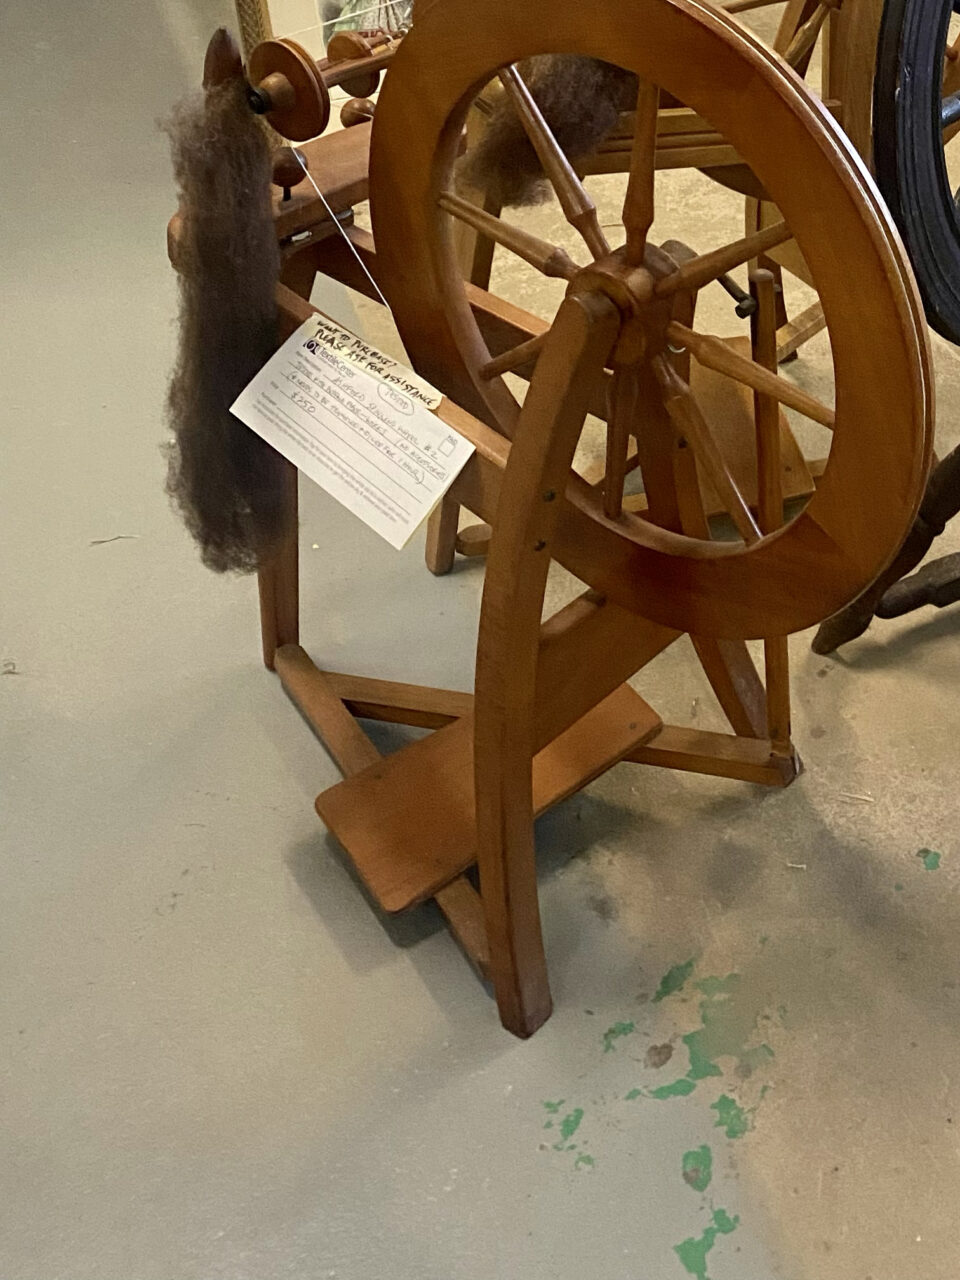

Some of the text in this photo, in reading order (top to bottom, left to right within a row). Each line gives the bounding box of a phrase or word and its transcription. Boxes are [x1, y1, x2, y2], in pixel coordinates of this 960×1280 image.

[317, 320, 339, 334] WANT
[313, 327, 436, 407] PLEASE ASK FOR ASSISTANCE
